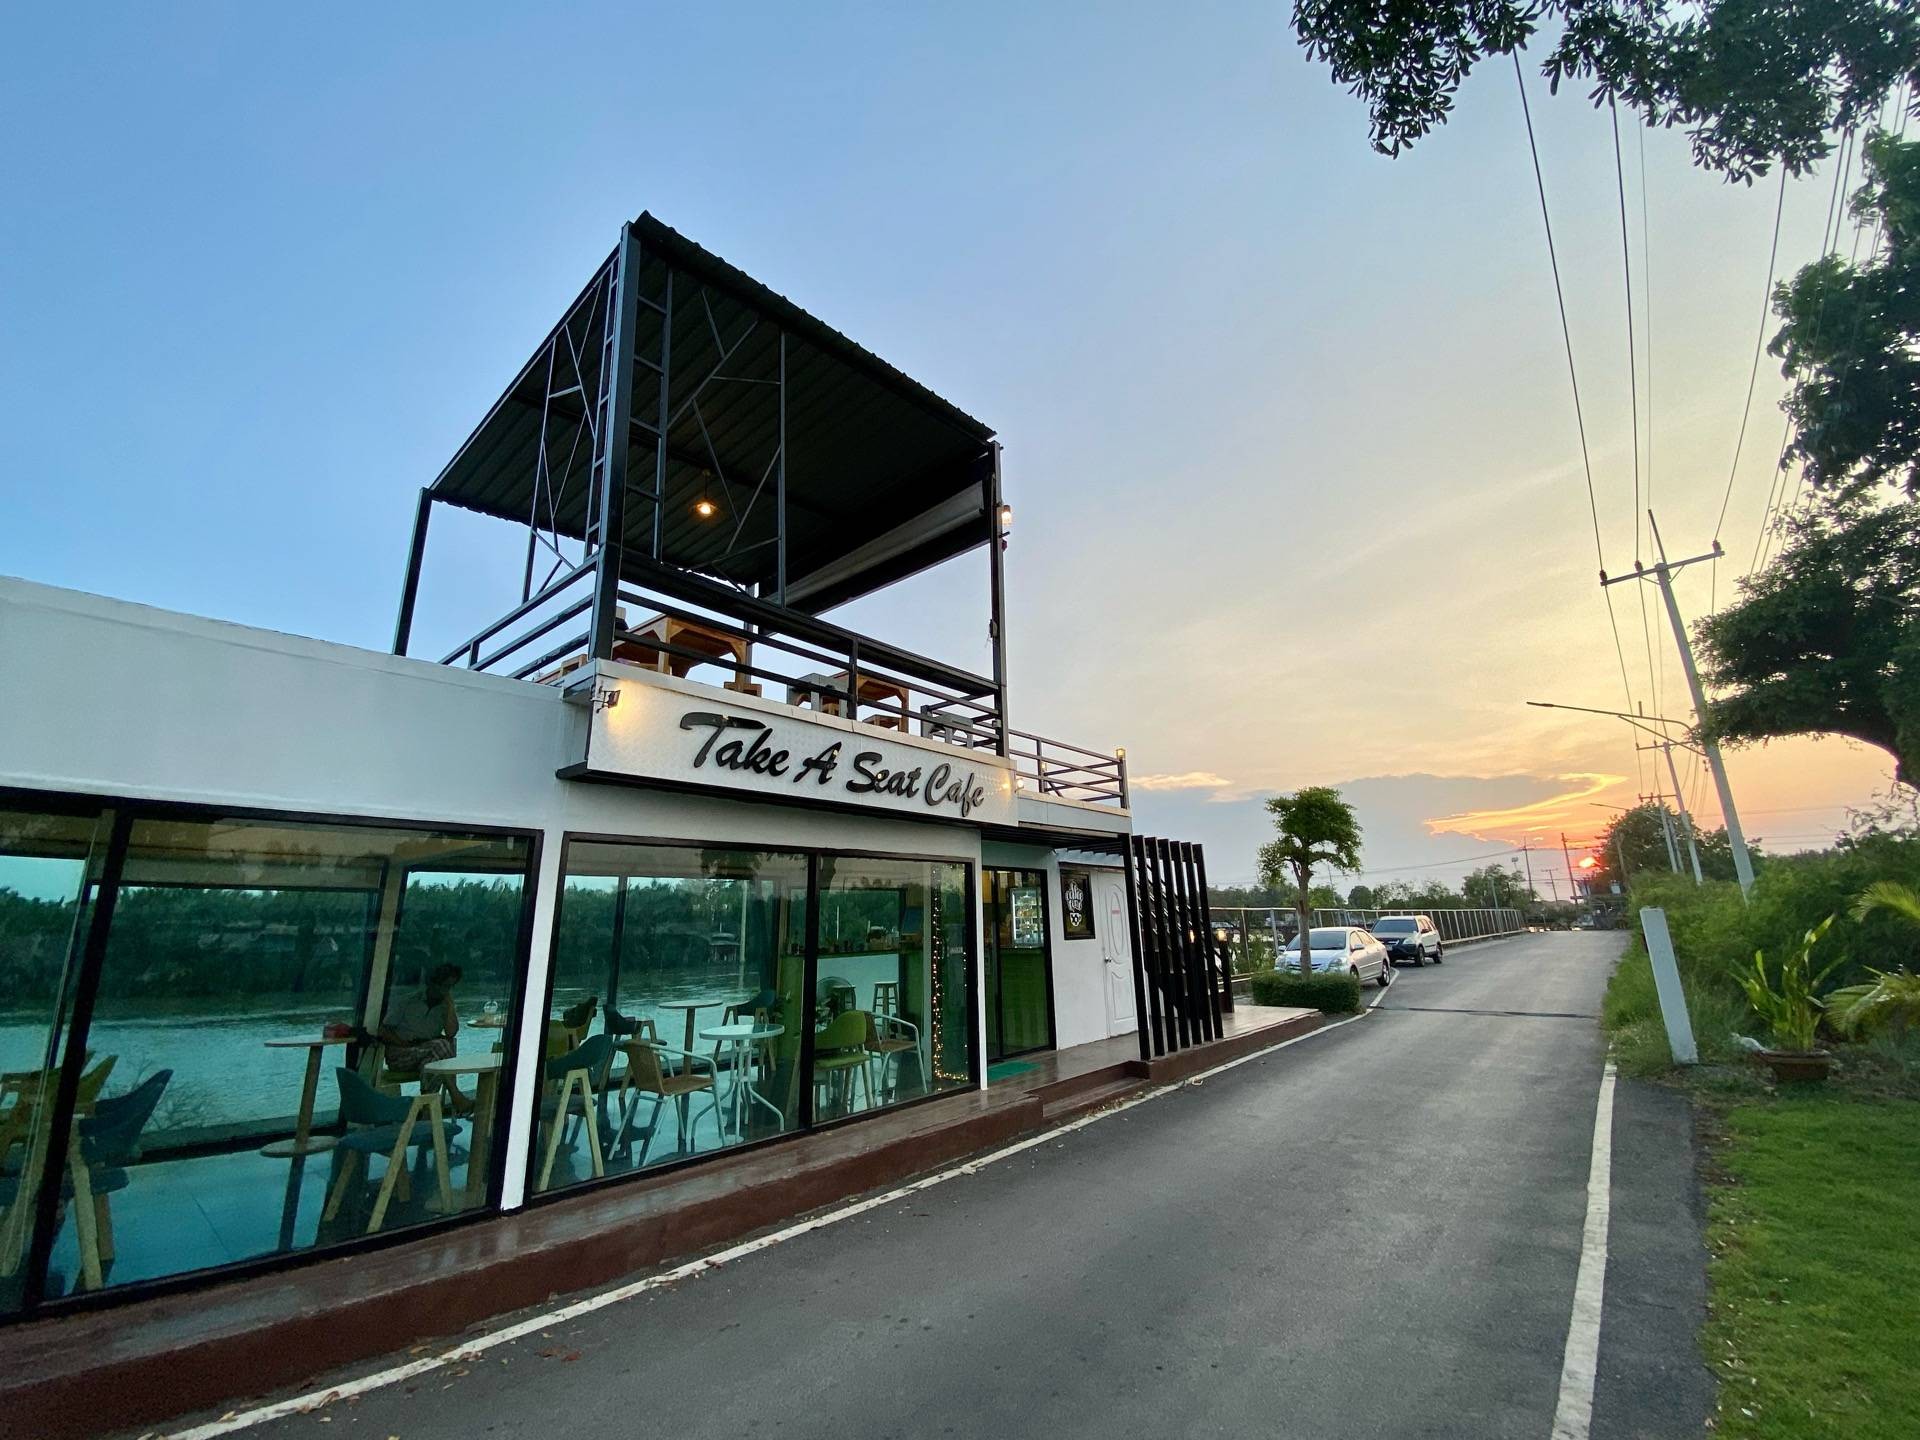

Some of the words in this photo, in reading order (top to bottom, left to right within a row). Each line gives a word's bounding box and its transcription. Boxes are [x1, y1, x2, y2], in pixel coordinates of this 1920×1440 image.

[679, 711, 790, 777] Take
[793, 741, 842, 785] A
[846, 751, 921, 798] Seat
[924, 762, 985, 818] Cafe
